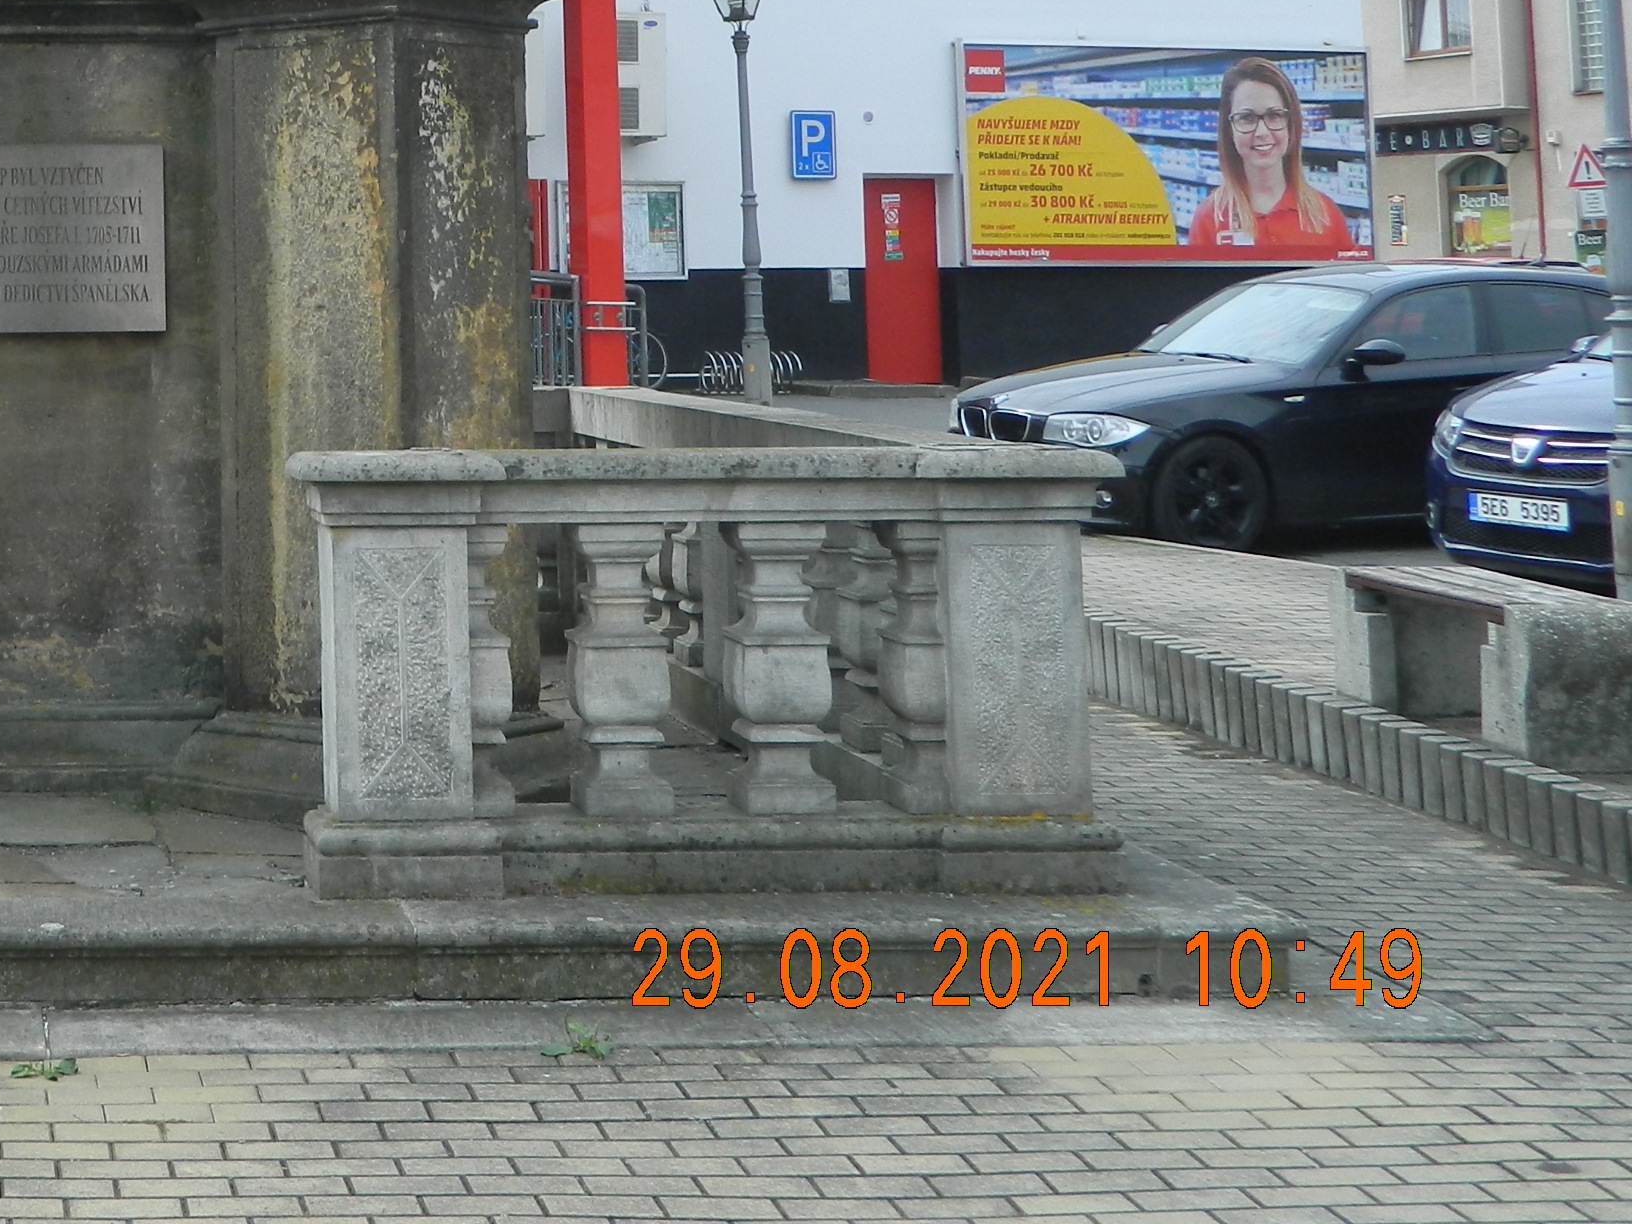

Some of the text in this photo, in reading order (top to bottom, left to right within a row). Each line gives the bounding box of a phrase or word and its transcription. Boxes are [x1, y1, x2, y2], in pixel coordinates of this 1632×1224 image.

[977, 117, 1081, 130] NAVYŠUJEME MZDY
[801, 119, 825, 157] P
[977, 132, 1082, 146] PŘIDEJTE SE K NÁM!
[1422, 128, 1464, 149] BAR
[11, 167, 37, 186] BYL
[40, 162, 104, 186] VZTYČEN
[1029, 164, 1046, 176] 26
[1050, 164, 1074, 177] 700
[1078, 163, 1094, 177] Kč
[979, 182, 1017, 192] Zástupce
[1030, 195, 1047, 208] 30
[1050, 195, 1076, 208] 800
[1079, 194, 1095, 208] Kč
[1458, 193, 1487, 208] Beer
[1052, 210, 1118, 224] ATRAKTIVNÍ
[1119, 214, 1169, 224] BENEFITY
[21, 226, 70, 245] JOSEFA
[87, 226, 141, 245] 1705-1711
[1577, 234, 1602, 245] Beer
[73, 249, 148, 273] ARMÁDAMI
[1480, 496, 1560, 523] 5E6 5395
